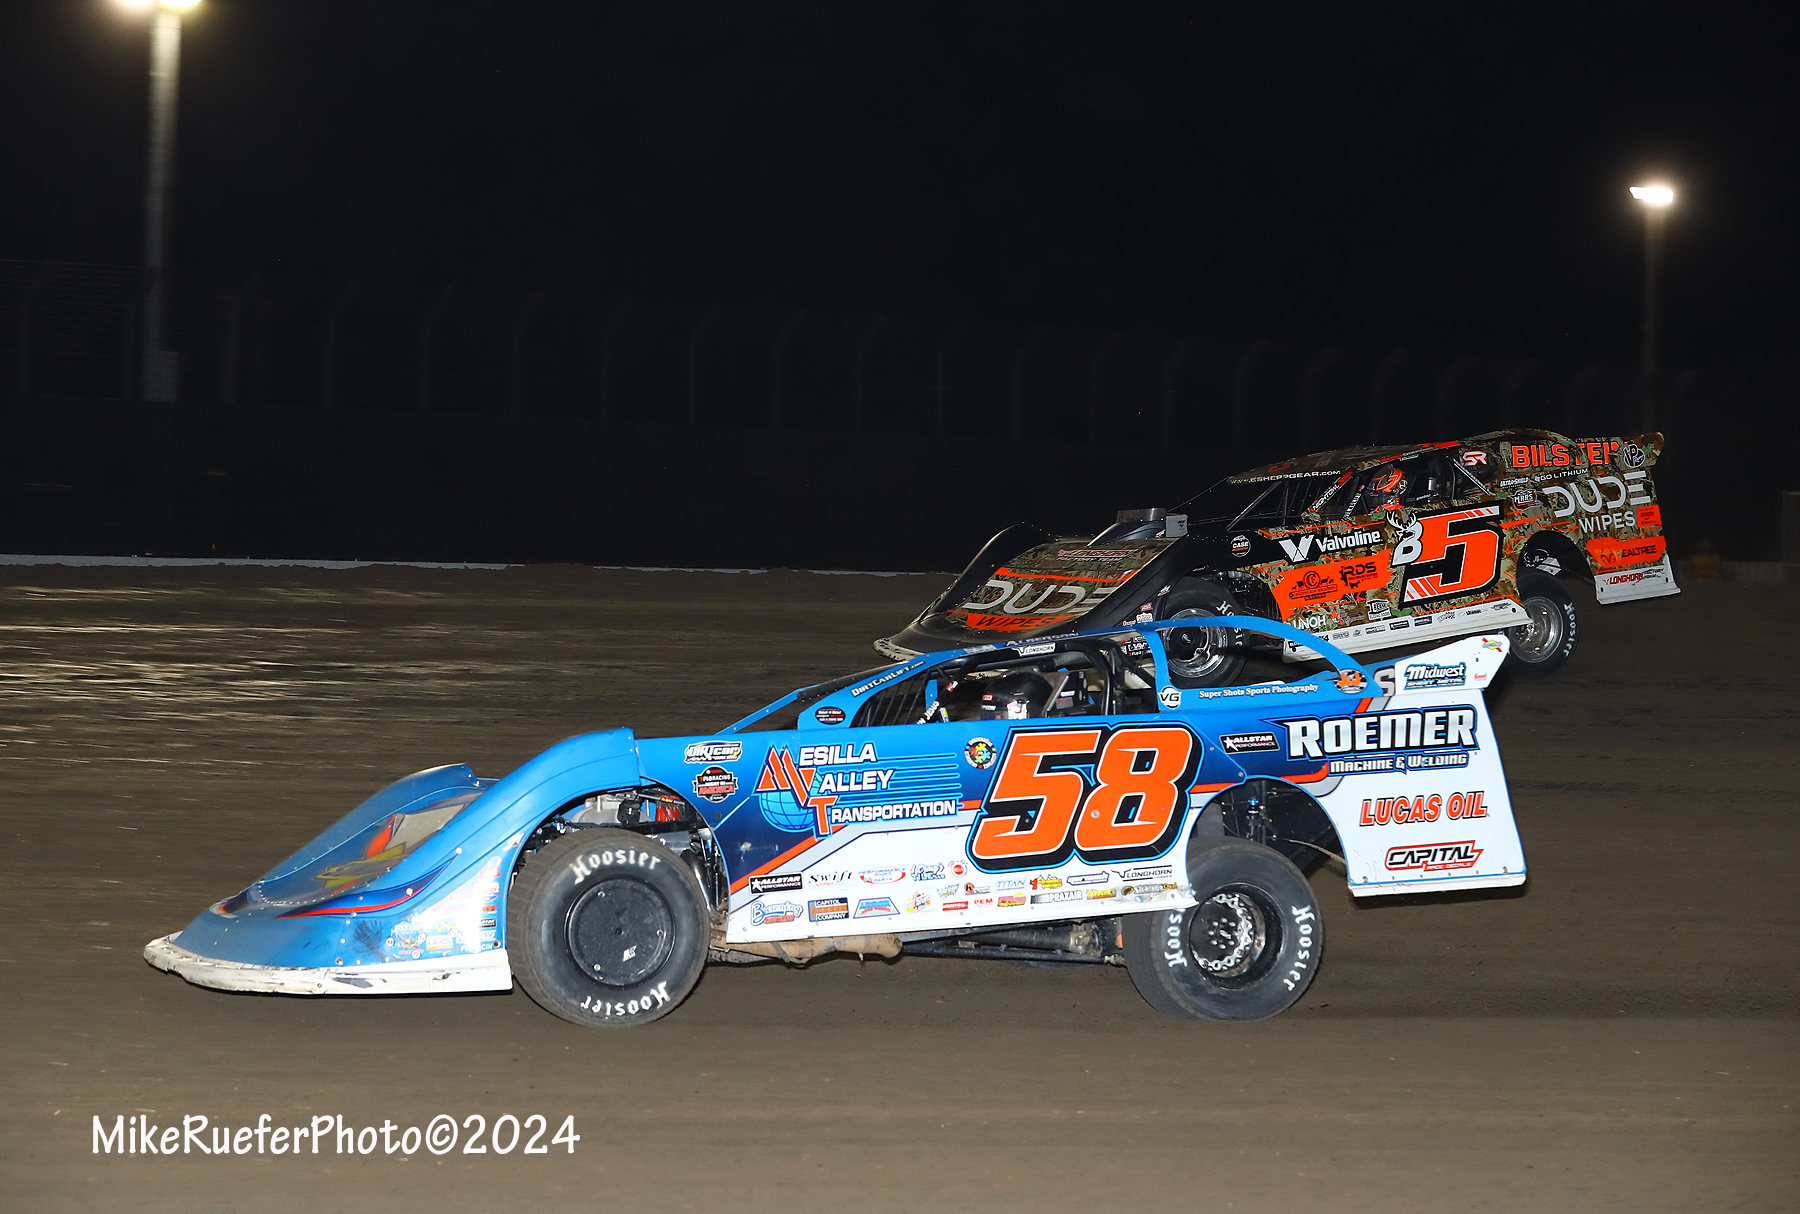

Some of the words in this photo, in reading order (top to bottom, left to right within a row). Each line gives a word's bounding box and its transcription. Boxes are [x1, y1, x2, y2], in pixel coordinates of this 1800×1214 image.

[1554, 468, 1589, 479] LITHIUM
[1542, 470, 1651, 518] DUDE
[1579, 510, 1636, 534] WIPES
[1232, 541, 1250, 549] CASE
[1315, 530, 1383, 553] Valvoline
[1616, 545, 1657, 558] REALTREE
[1341, 561, 1377, 576] RDS
[1609, 572, 1644, 585] LONGHORN
[962, 579, 1116, 614] DUDE
[977, 615, 1057, 628] WIPES
[1563, 602, 1577, 657] Hoosier
[1406, 663, 1465, 680] Midwest
[1160, 692, 1181, 702] VG
[1199, 690, 1222, 699] Super
[1223, 688, 1245, 697] Shots
[1246, 687, 1271, 697] Sports
[1272, 683, 1319, 695] Photography
[924, 700, 940, 721] JESUS
[1232, 734, 1273, 744] ALLSTAR
[1284, 709, 1476, 758] ROEMER
[1233, 741, 1276, 749] PERFORMANCE
[1330, 758, 1394, 773] MACHINE
[1395, 754, 1406, 769] &
[1407, 753, 1468, 768] WELDING
[970, 726, 1195, 860] 58
[1360, 793, 1443, 826] LUCAS
[1446, 791, 1488, 819] OIL
[1388, 845, 1475, 866] CAPITAL
[569, 846, 662, 885] Hoosier
[1126, 869, 1173, 879] LONGHORN
[760, 876, 801, 885] ALLSTAR
[808, 870, 853, 884] Swift
[997, 879, 1026, 889] TITAN
[1049, 889, 1083, 903] PRAXAIR
[1163, 908, 1188, 968] Hoos
[1284, 904, 1317, 992] Hoosier
[580, 981, 672, 1020] Hoosier
